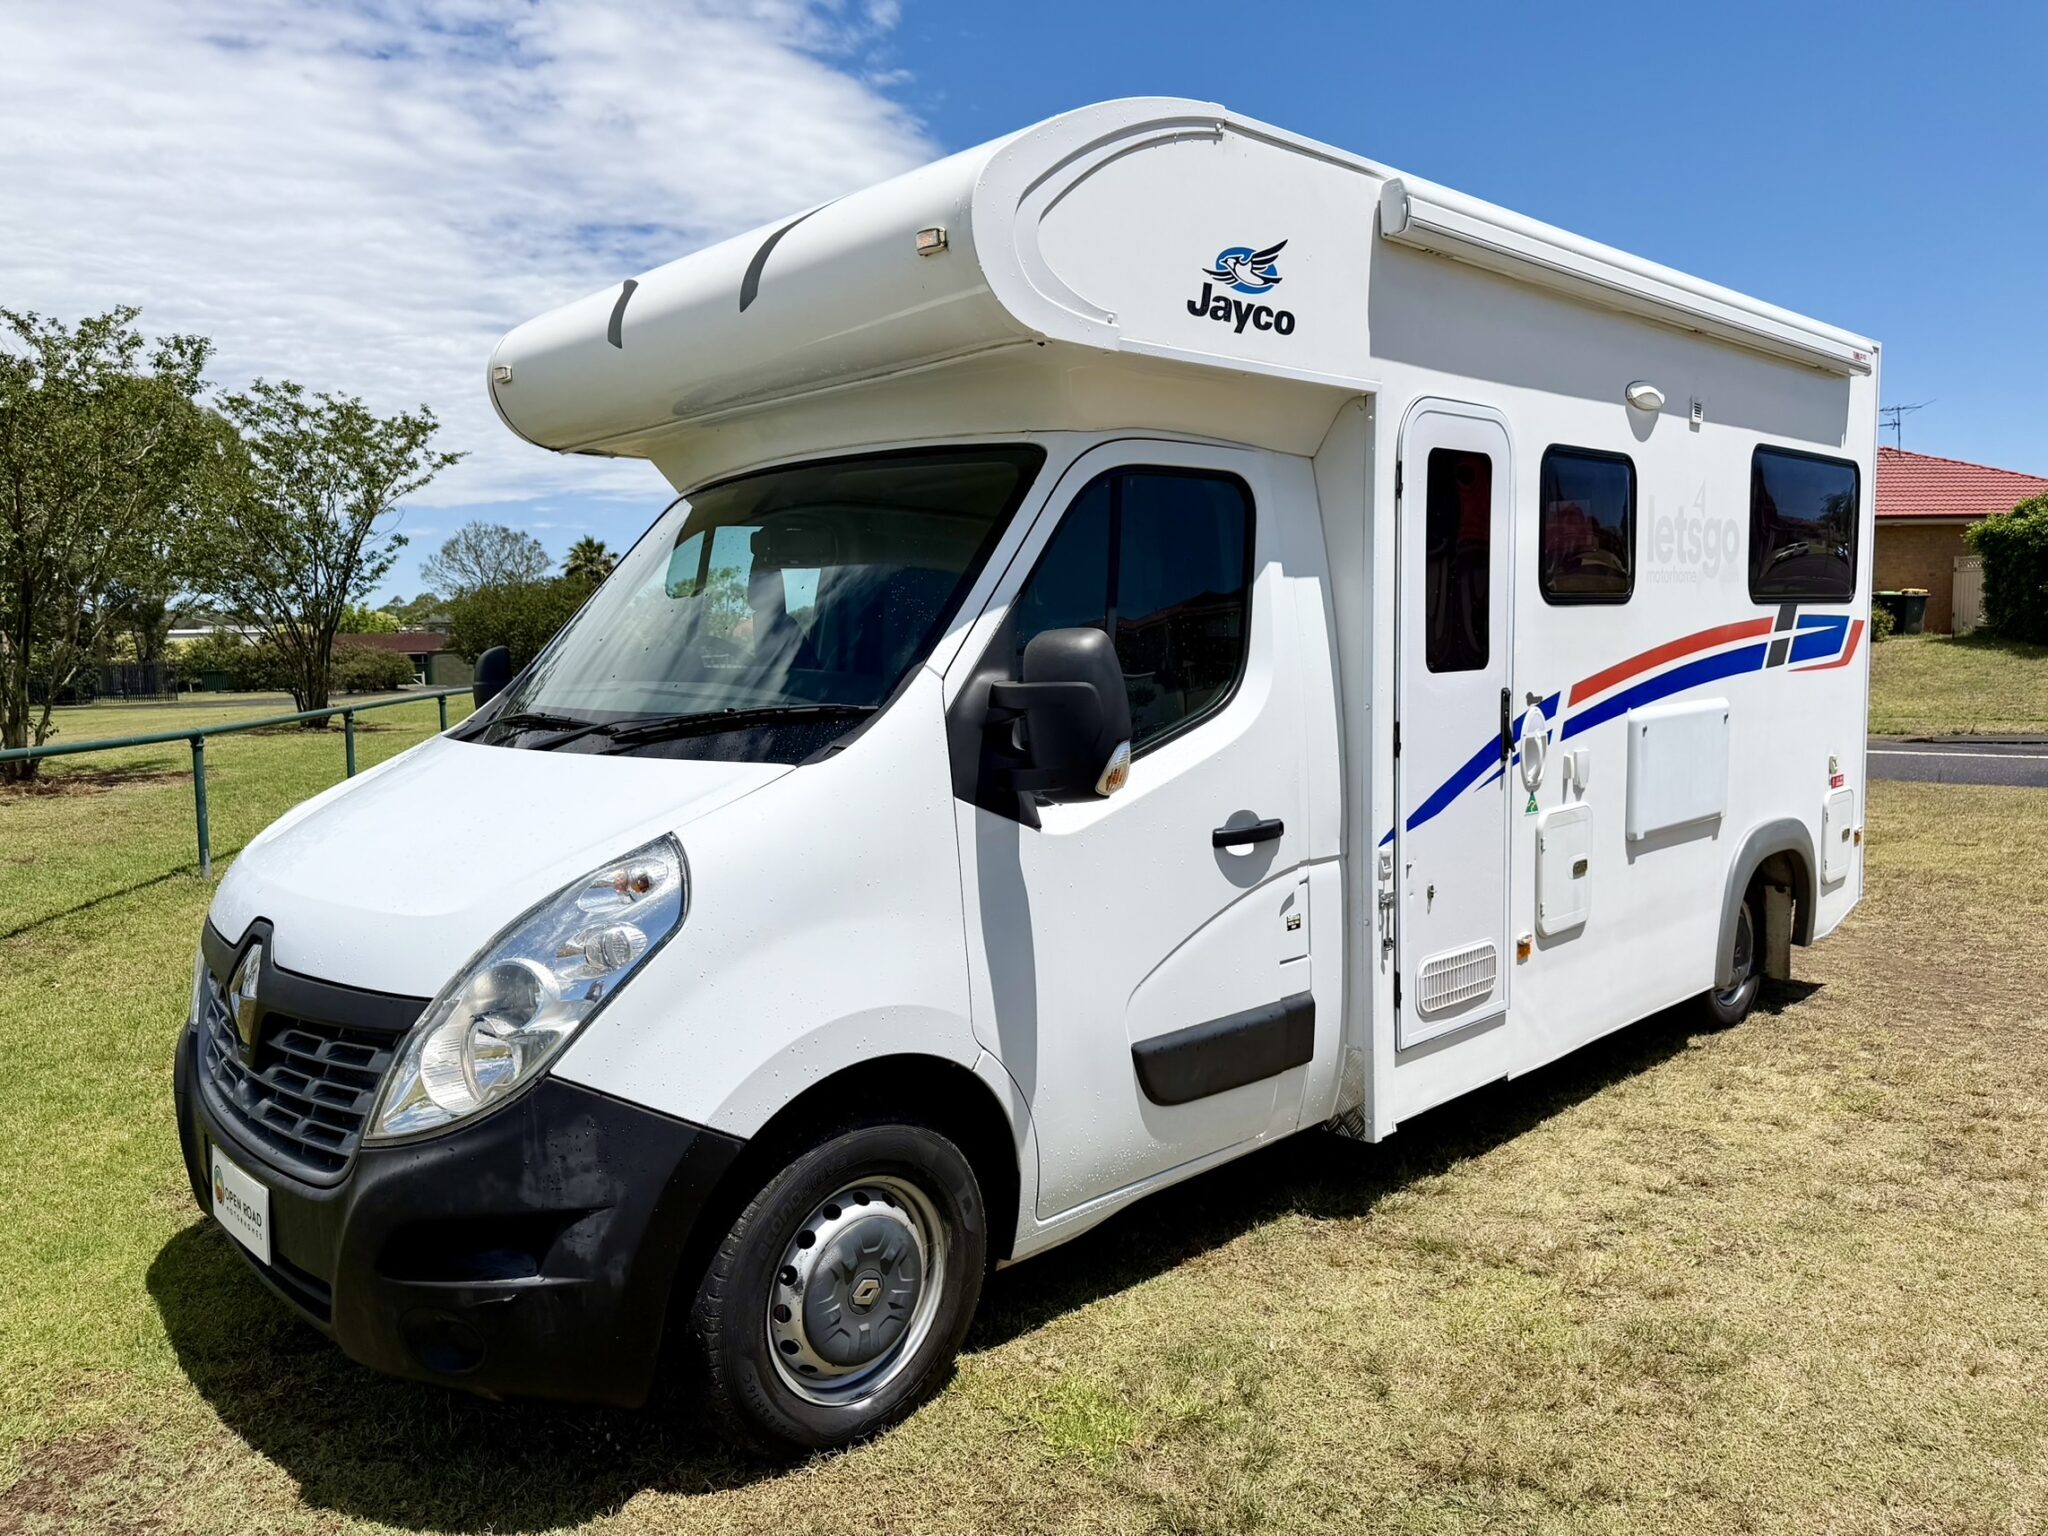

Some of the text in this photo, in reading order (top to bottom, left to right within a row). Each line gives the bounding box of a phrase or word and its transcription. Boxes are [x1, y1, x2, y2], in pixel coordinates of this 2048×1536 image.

[1187, 282, 1296, 336] Jayco
[1647, 494, 1740, 579] letsgo
[225, 1186, 263, 1228] OPEN ROAD
